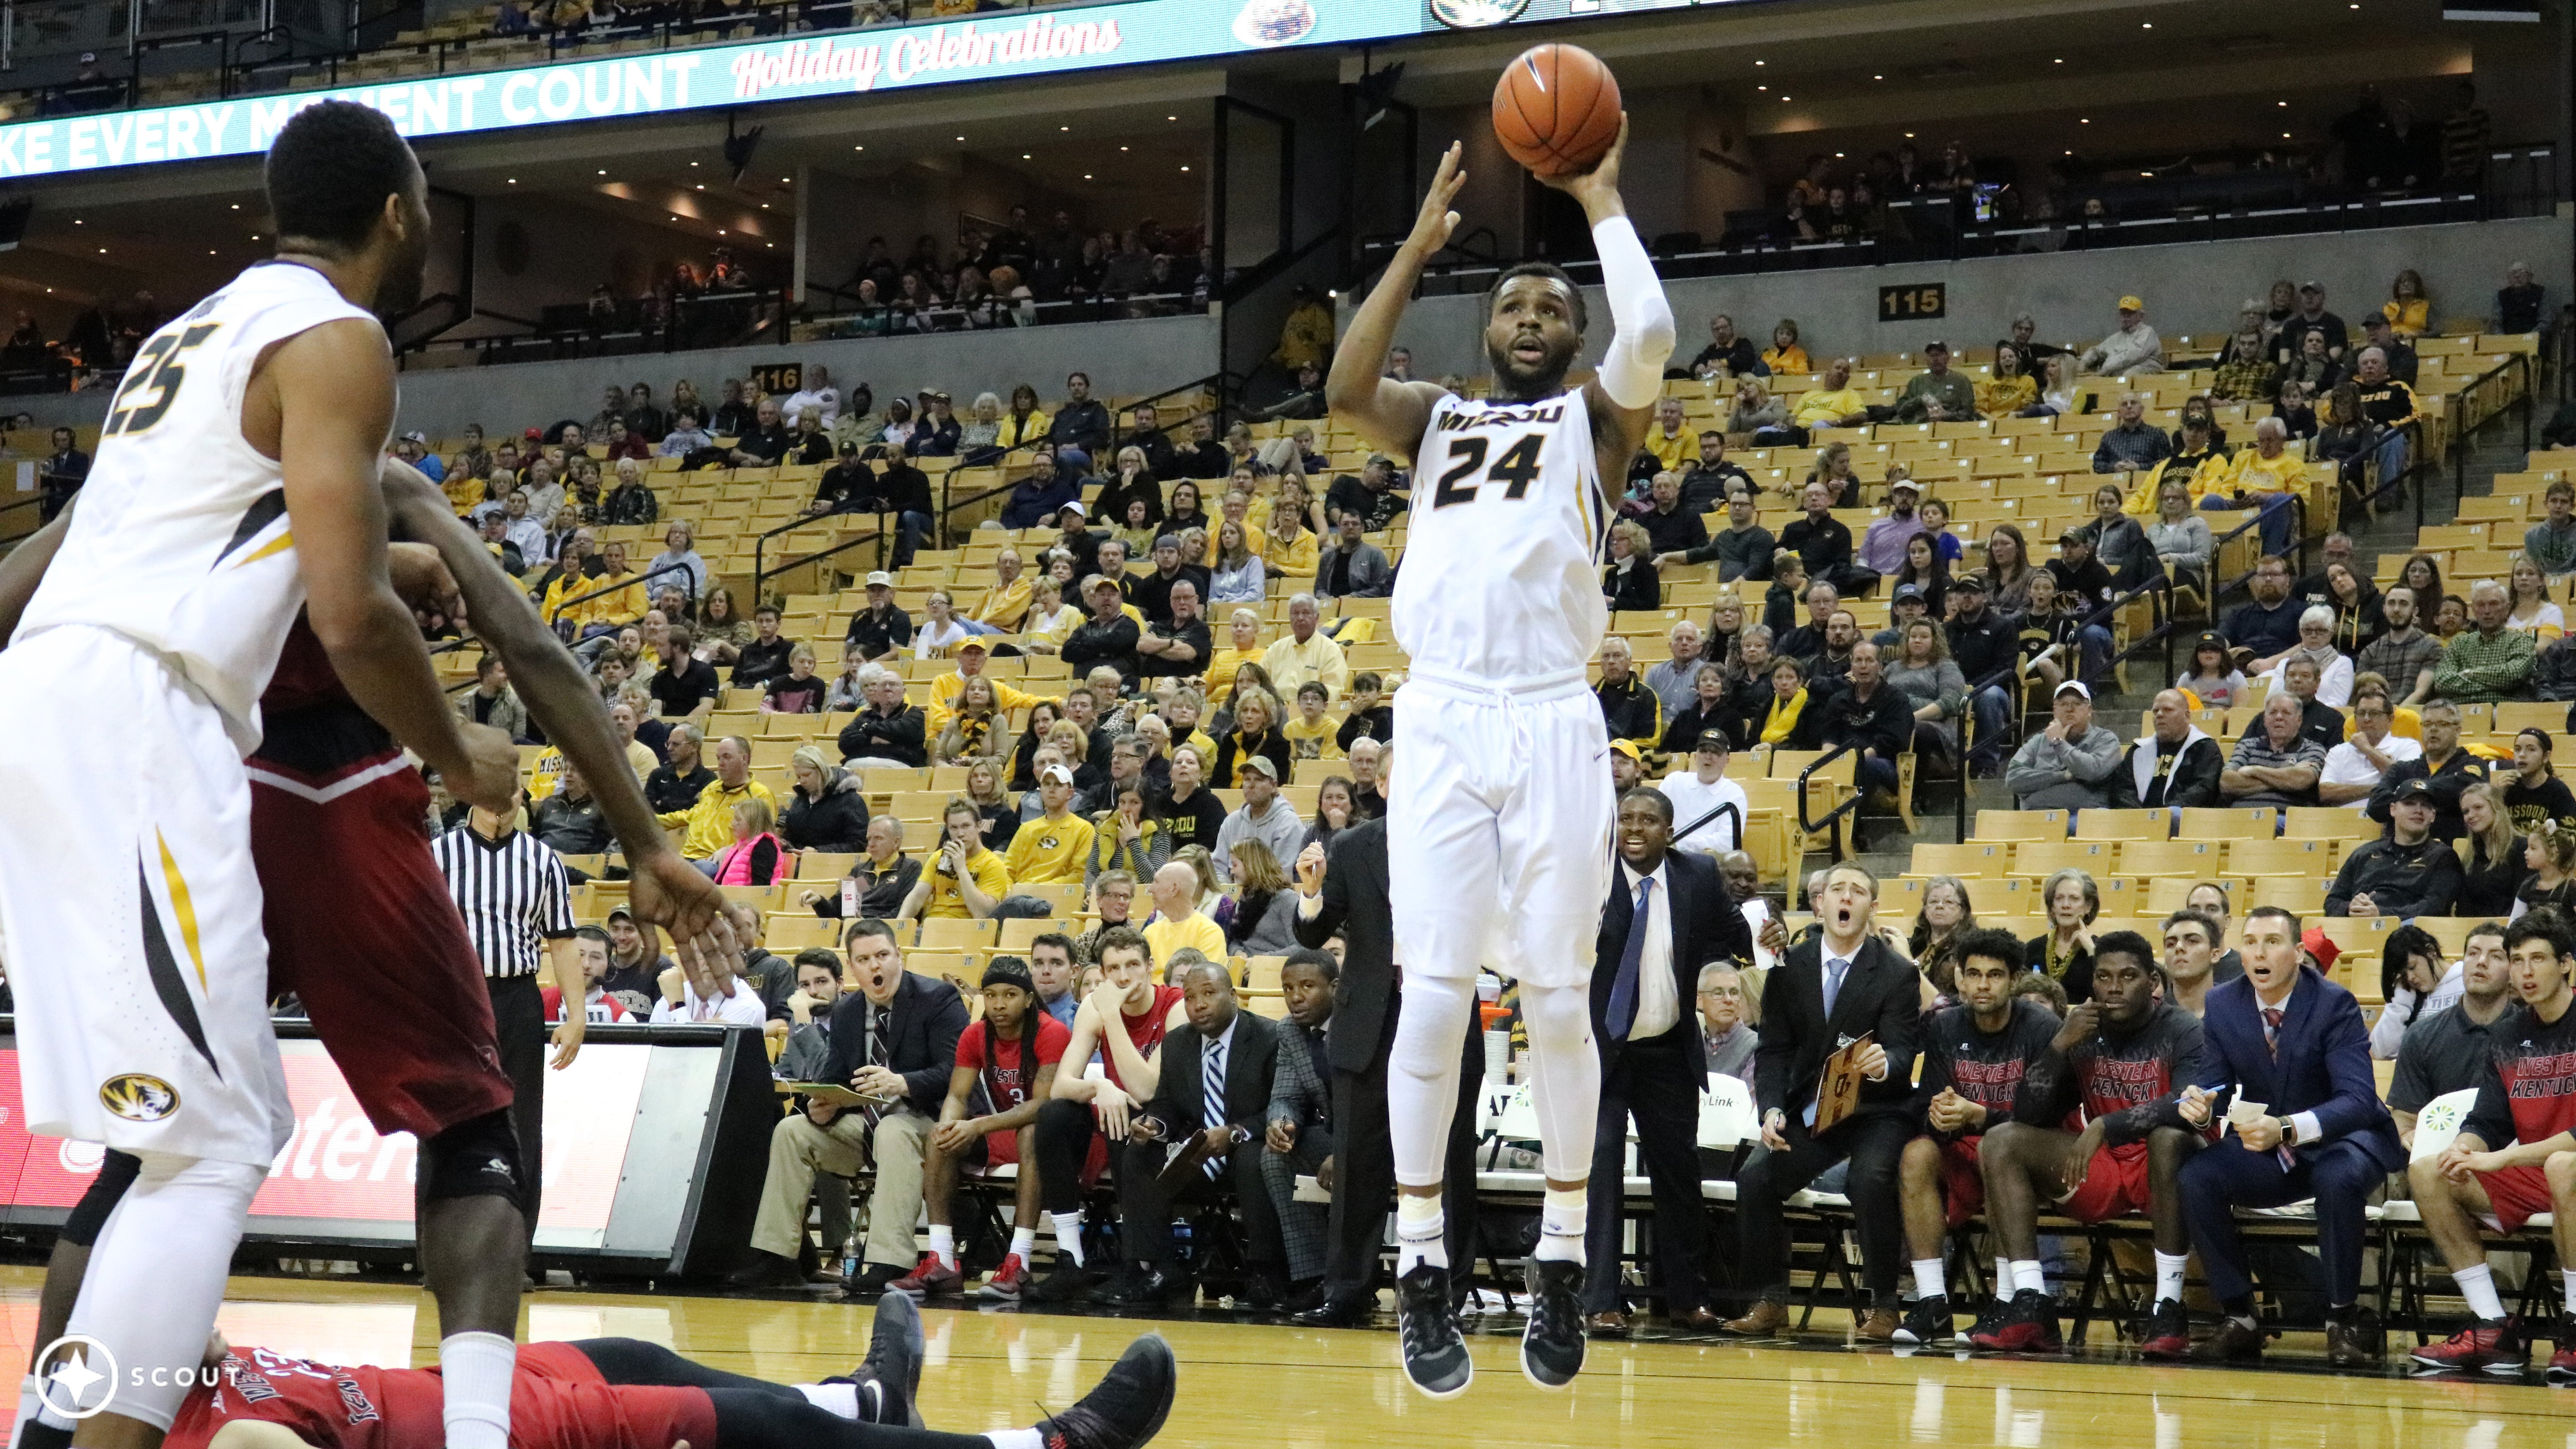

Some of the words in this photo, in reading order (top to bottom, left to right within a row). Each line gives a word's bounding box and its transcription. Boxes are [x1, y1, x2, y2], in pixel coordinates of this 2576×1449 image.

[730, 38, 884, 98] Holiday
[887, 14, 1125, 83] Celebrations
[69, 104, 234, 156] EVERY
[250, 76, 485, 149] MENT
[500, 54, 701, 123] COUNT
[1884, 289, 1939, 314] 115
[100, 321, 224, 441] 25
[757, 368, 797, 390] 116
[1433, 432, 1548, 512] 24
[1794, 835, 1801, 847] M
[821, 921, 829, 930] 14
[897, 921, 905, 930] 15
[978, 921, 985, 930] 16
[1058, 922, 1066, 931] 17
[964, 957, 972, 966] 17
[1955, 1057, 2023, 1083] WESTERN
[2094, 1056, 2160, 1081] WESTERN
[2517, 1051, 2576, 1076] WESTE
[1009, 1088, 1025, 1109] 3
